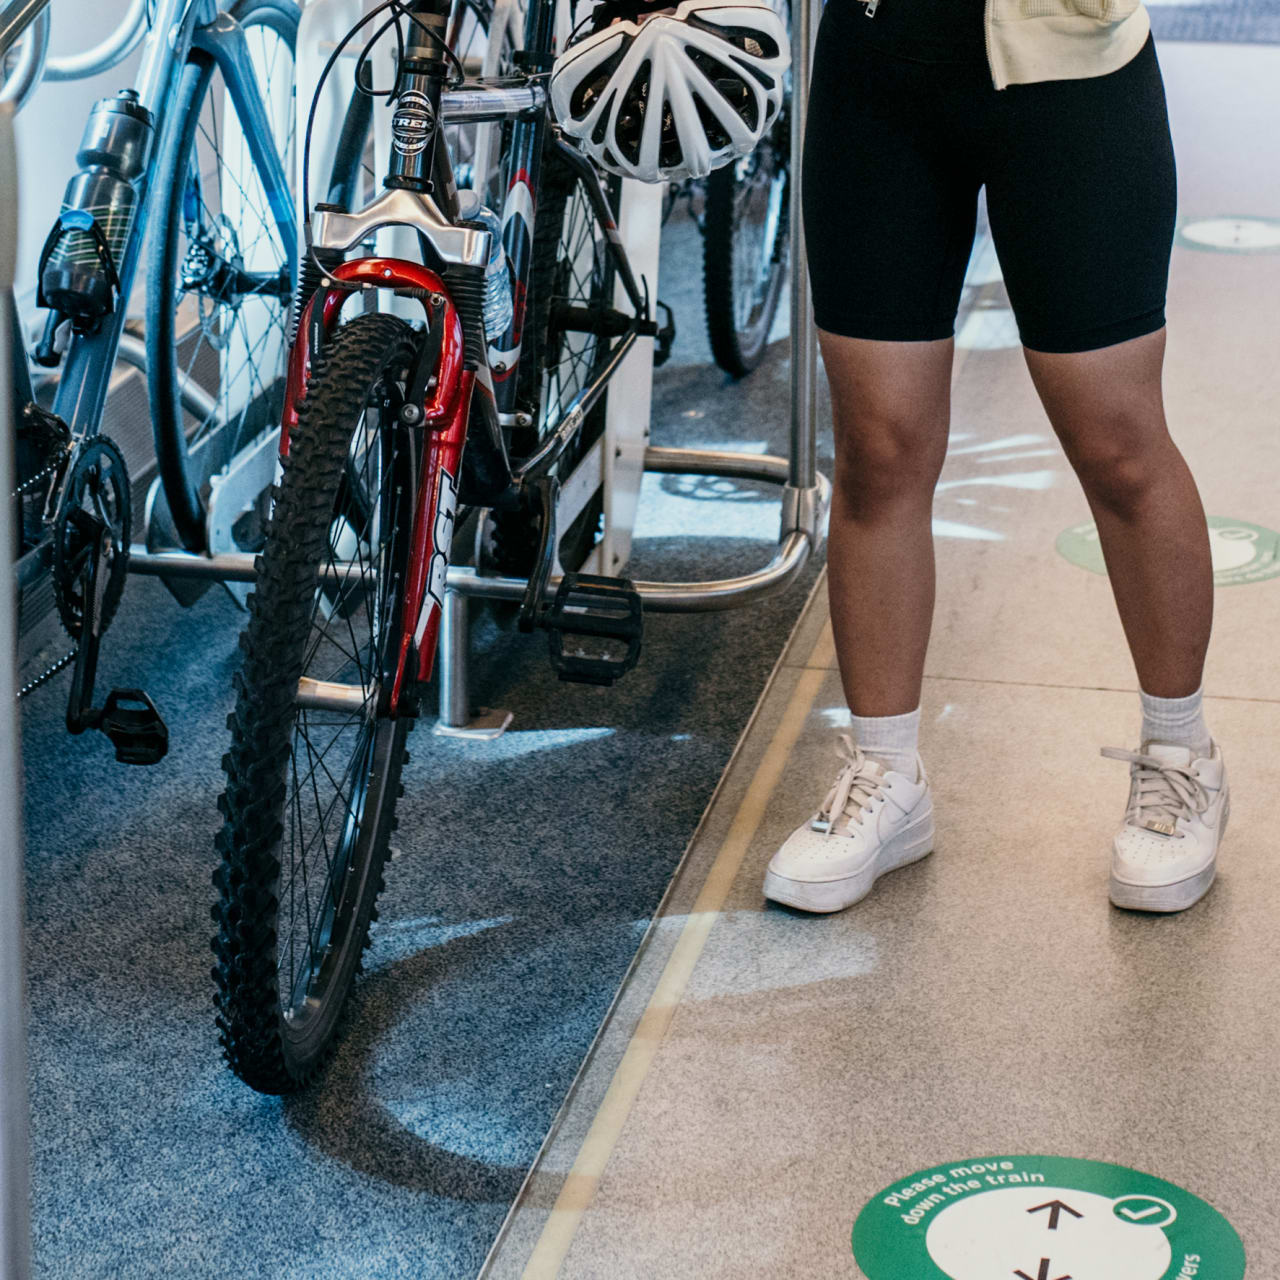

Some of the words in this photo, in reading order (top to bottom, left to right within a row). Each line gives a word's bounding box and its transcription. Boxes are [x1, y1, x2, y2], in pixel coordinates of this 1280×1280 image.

[394, 118, 433, 129] TREK
[883, 1174, 947, 1207] Please
[949, 1161, 1014, 1178] move
[901, 1193, 946, 1225] down
[942, 1179, 982, 1196] the
[985, 1172, 1045, 1186] train
